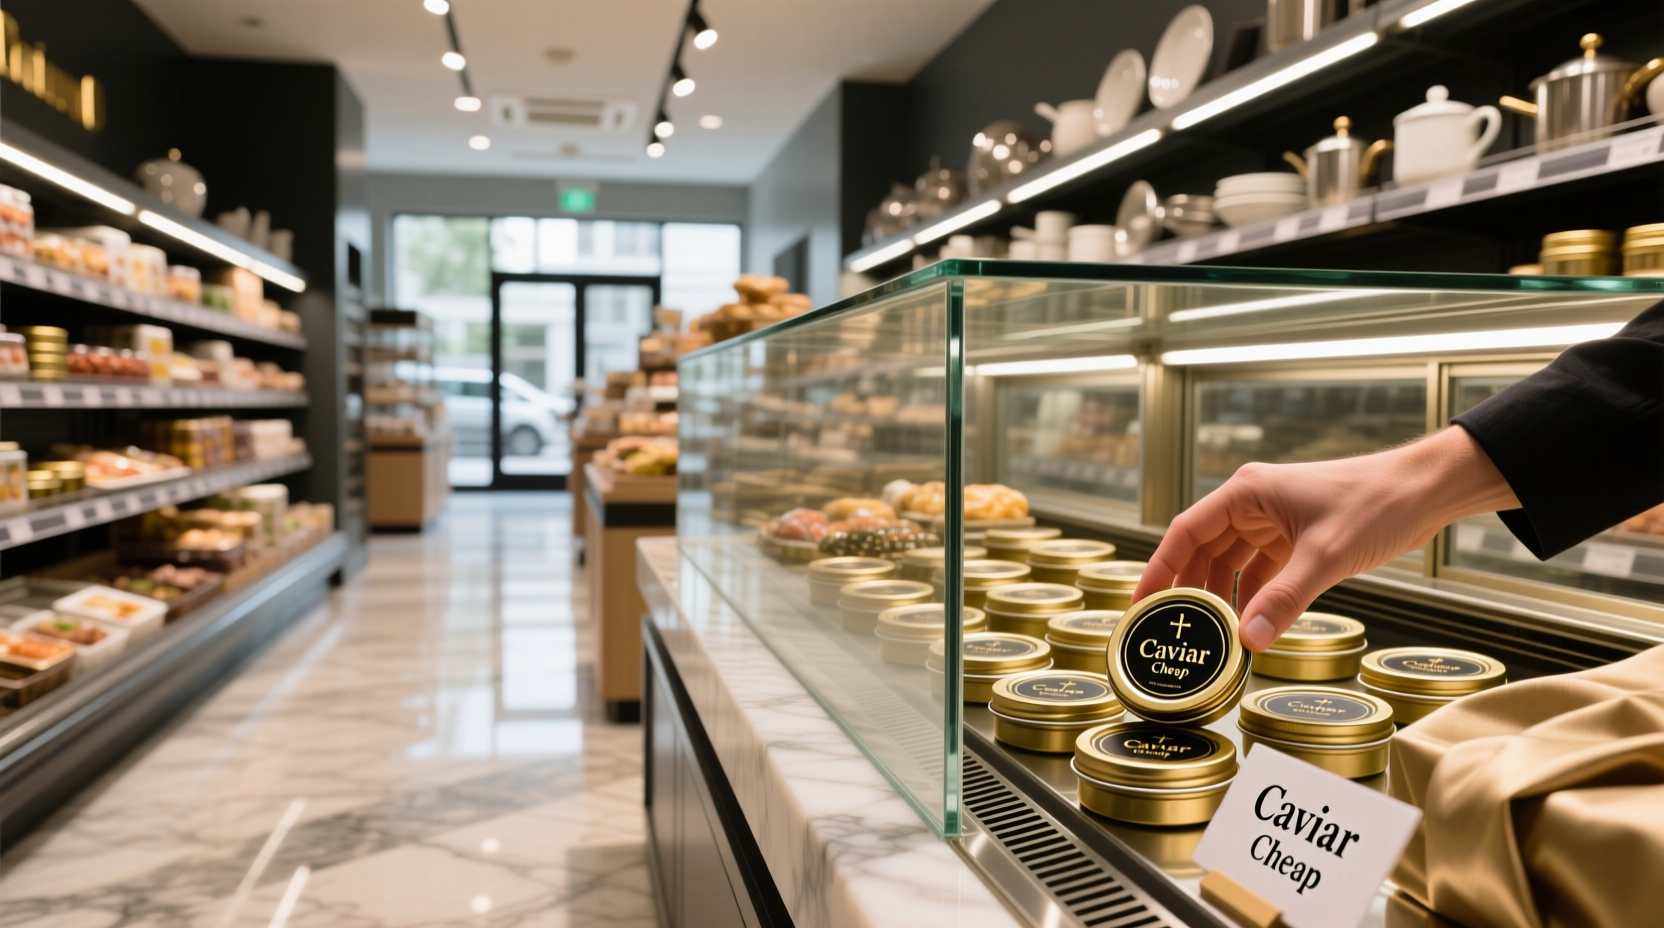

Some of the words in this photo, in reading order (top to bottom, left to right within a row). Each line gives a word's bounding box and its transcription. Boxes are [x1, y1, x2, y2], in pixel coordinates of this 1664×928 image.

[1139, 638, 1210, 665] Caviar
[1151, 661, 1189, 680] Cheap
[1254, 784, 1360, 858] Caviar
[1250, 834, 1321, 895] Cheap
